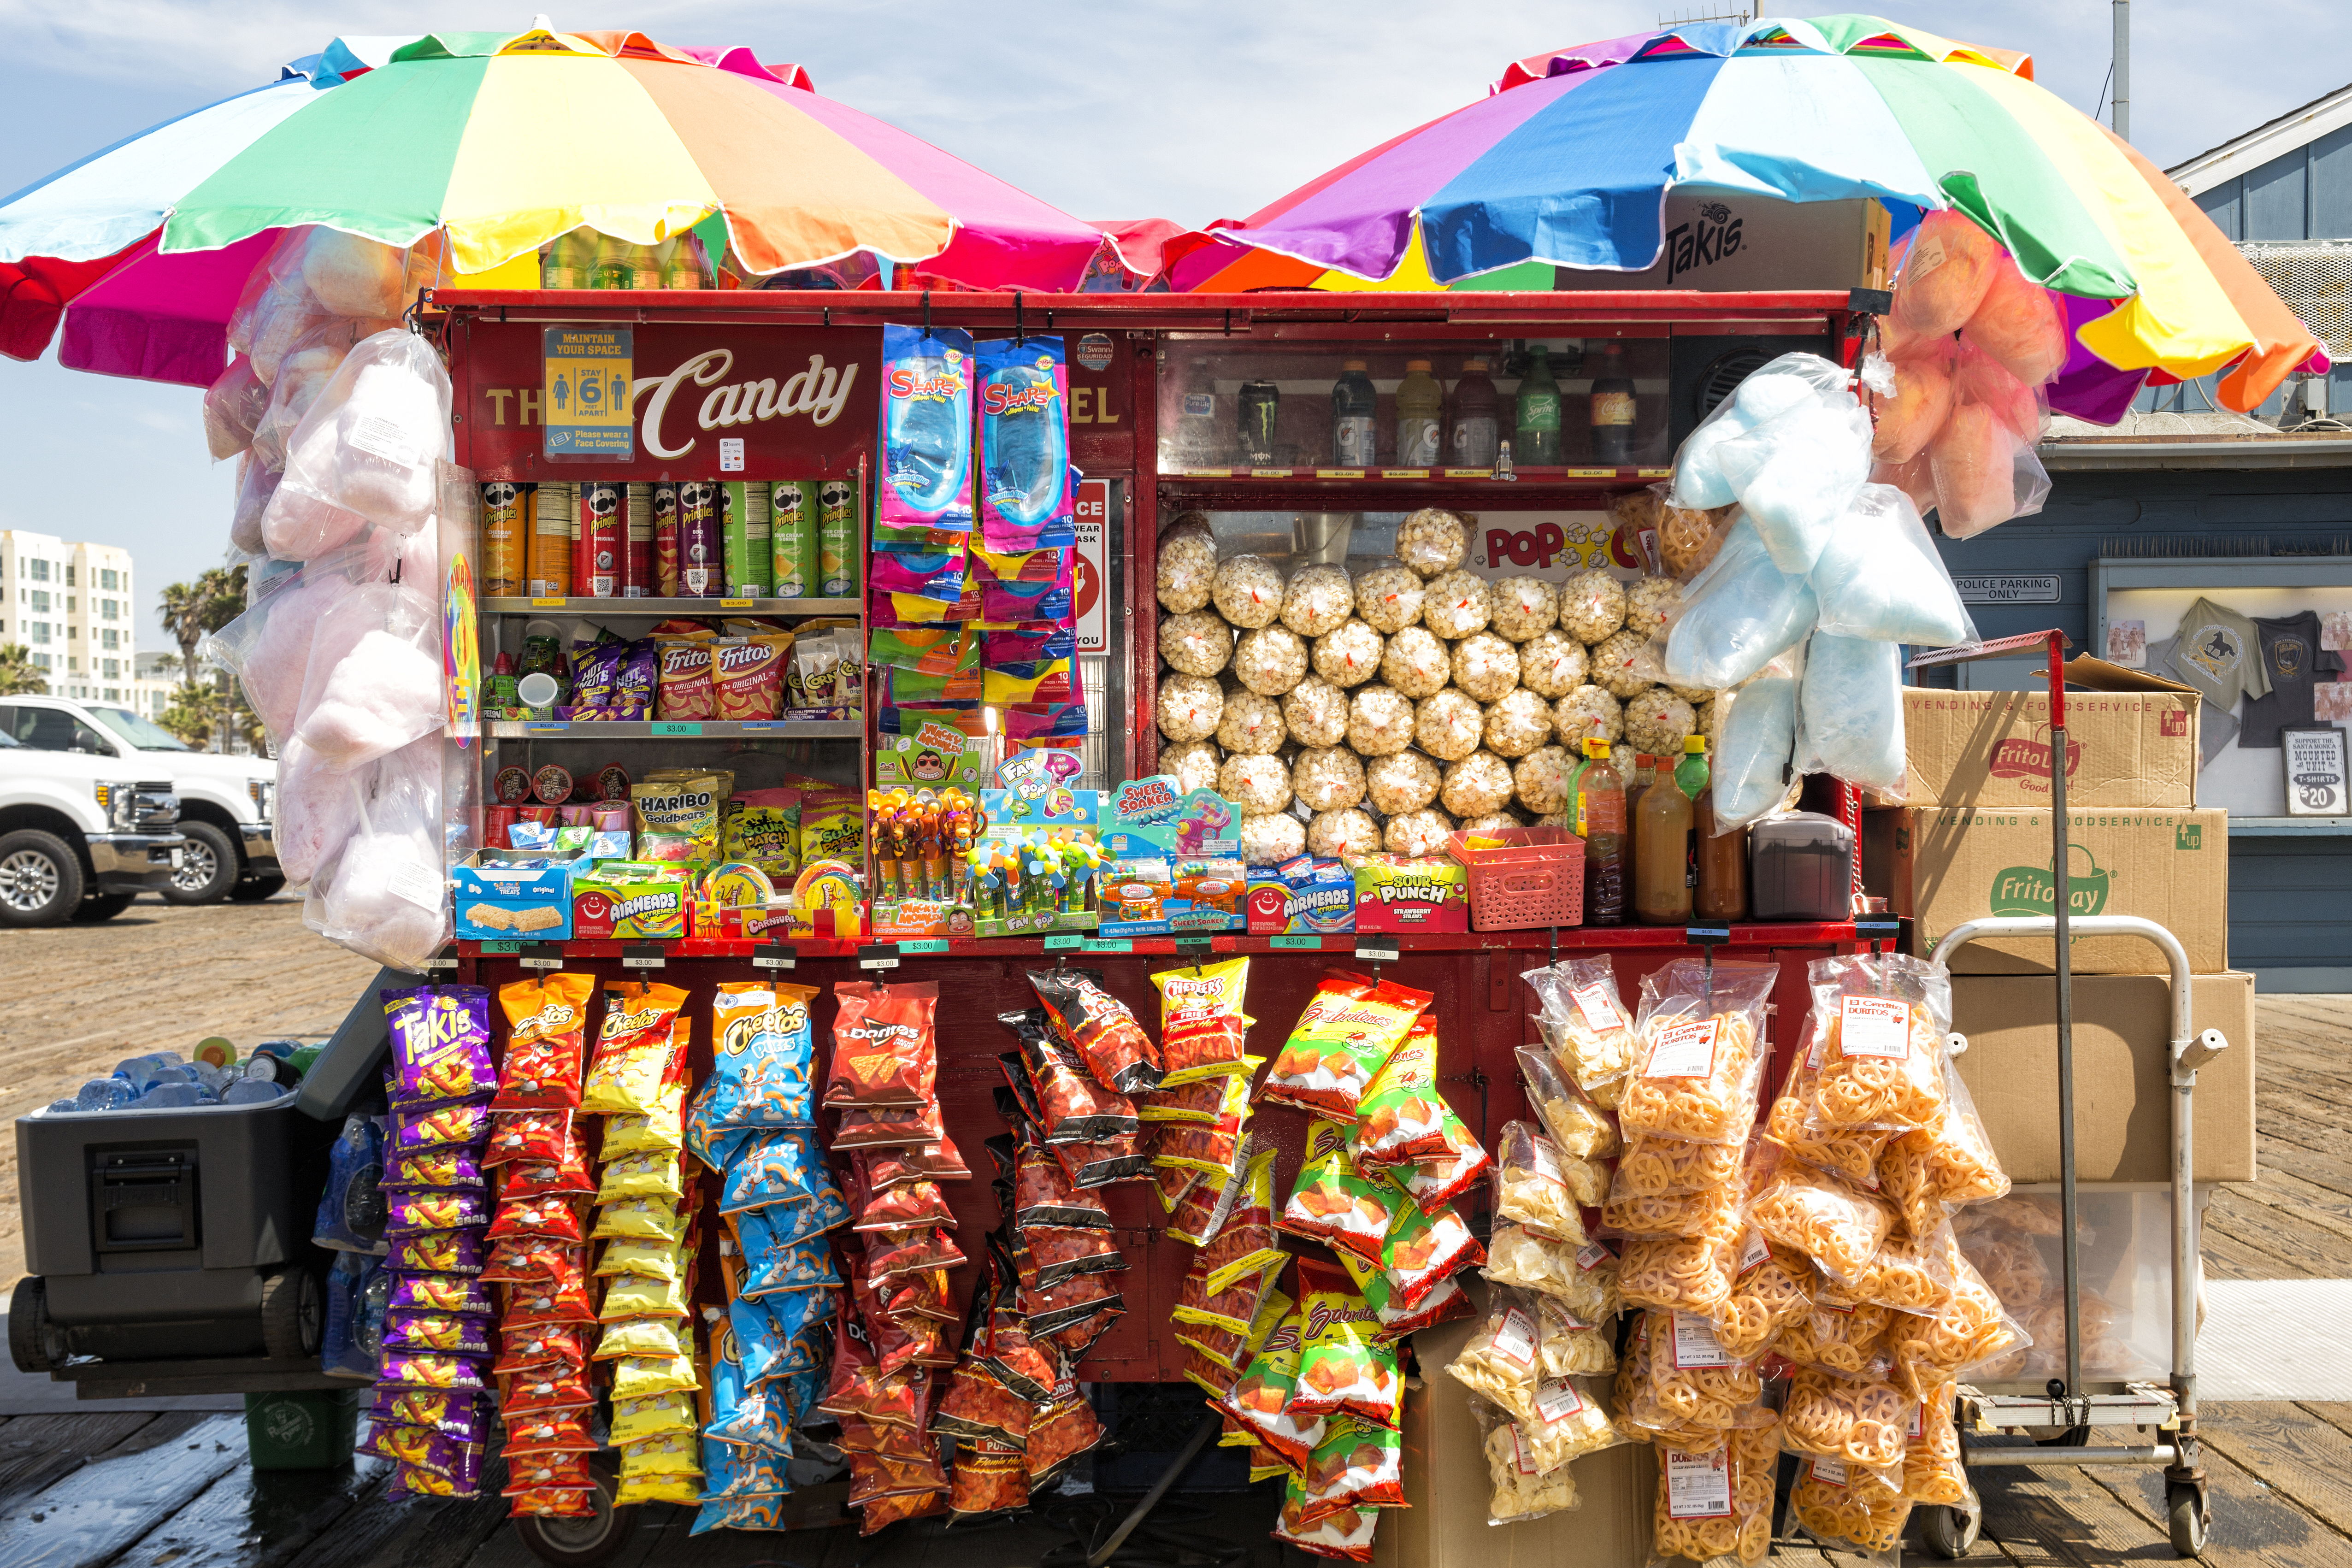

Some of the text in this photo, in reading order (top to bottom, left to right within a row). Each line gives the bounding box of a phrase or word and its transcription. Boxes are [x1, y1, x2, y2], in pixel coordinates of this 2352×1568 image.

[563, 334, 614, 343] MAINTAIN
[557, 345, 621, 354] YOUR SPACE
[580, 377, 601, 403] 6
[632, 348, 859, 460] Candy
[1528, 404, 1553, 415] Sprite
[596, 440, 629, 448] Covering
[485, 507, 517, 529] Pringles
[590, 514, 618, 535] Pringles
[683, 506, 713, 528] Pringles
[775, 510, 804, 532] Pringles
[1486, 522, 1564, 569] POP
[2001, 579, 2050, 588] PARKING
[1989, 590, 2019, 598] ONLY
[2193, 626, 2205, 641] Santa
[2224, 626, 2237, 637] Police
[578, 655, 596, 672] Takis
[719, 645, 772, 671] Fritos
[584, 661, 605, 681] HOT
[579, 670, 608, 691] NUTS
[674, 677, 710, 690] ORIGINAL
[732, 673, 768, 690] ORIGINAL
[1912, 701, 2152, 712] VENDING & FODSERVICE
[924, 722, 963, 744] WACKY
[2171, 719, 2184, 735] up
[918, 732, 963, 755] MONKEY
[2295, 751, 2335, 760] MOUNTED
[2306, 761, 2325, 771] UNIT
[1124, 782, 1166, 801] SWEET
[2020, 779, 2049, 793] Good
[640, 792, 711, 812] HARIBO
[2299, 785, 2327, 805] $20
[1119, 792, 1173, 815] SOAKER
[1130, 803, 1173, 817] Candy Filled
[645, 810, 706, 824] Goldbears
[1939, 816, 2174, 826] VENDING & OODSERVICE
[692, 817, 713, 834] Sour
[743, 822, 784, 837] SOUR
[745, 832, 789, 849] PATCH
[2187, 834, 2199, 849] up
[1394, 876, 1431, 887] SOUR
[1380, 886, 1447, 905] PUNCH
[2001, 877, 2098, 912] Fritoay
[610, 892, 677, 922] AIRHEADS
[900, 903, 940, 914] WACKY
[1284, 890, 1349, 917] AIRHEADS
[1317, 905, 1349, 914] XTREMES
[644, 908, 676, 920] XTREMES
[898, 912, 944, 925] MONKEY
[748, 915, 796, 935] CARNIVAL
[787, 921, 813, 931] POPS
[1004, 913, 1055, 932] FAN POP
[498, 942, 528, 952] $3.00
[1164, 978, 1223, 1001] CHESTER'S
[1181, 1011, 1208, 1019] FRIES
[1293, 1000, 1393, 1032] Sabritones
[601, 1008, 661, 1040] Cheetos
[1169, 1019, 1218, 1034] Flamin' Hot
[1675, 1025, 1711, 1036] Cerdito
[395, 1008, 472, 1065] Takis
[524, 1026, 554, 1039] Crunchy
[724, 1008, 807, 1057] Cheetos
[850, 1025, 919, 1040] Doritos
[1660, 1033, 1696, 1047] DURITOS
[431, 1048, 448, 1060] FUEGO
[752, 1039, 795, 1058] PUFFS
